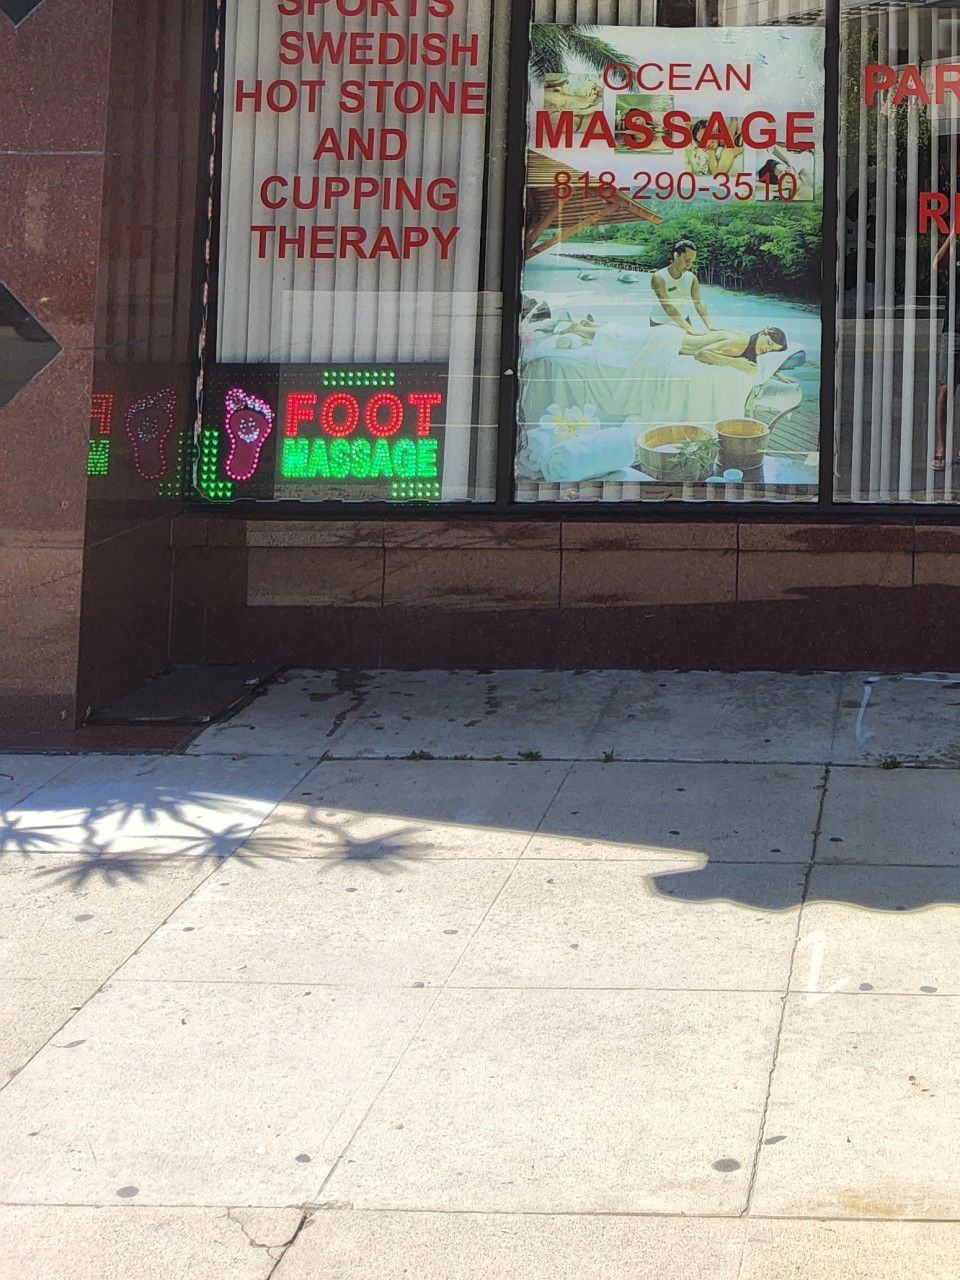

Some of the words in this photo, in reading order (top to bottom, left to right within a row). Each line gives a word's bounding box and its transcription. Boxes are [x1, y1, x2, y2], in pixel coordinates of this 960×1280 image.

[279, 31, 479, 67] SWEDISH
[602, 63, 752, 92] OCEAN
[235, 79, 325, 114] HOT
[340, 80, 486, 115] STONE
[313, 128, 408, 161] AND
[534, 110, 816, 151] MASSAGE
[260, 175, 458, 211] CUPPING
[551, 170, 798, 203] 818-290-3510
[251, 225, 459, 260] THERAPY
[284, 391, 443, 438] FOOT
[279, 436, 439, 480] MASSAGE
